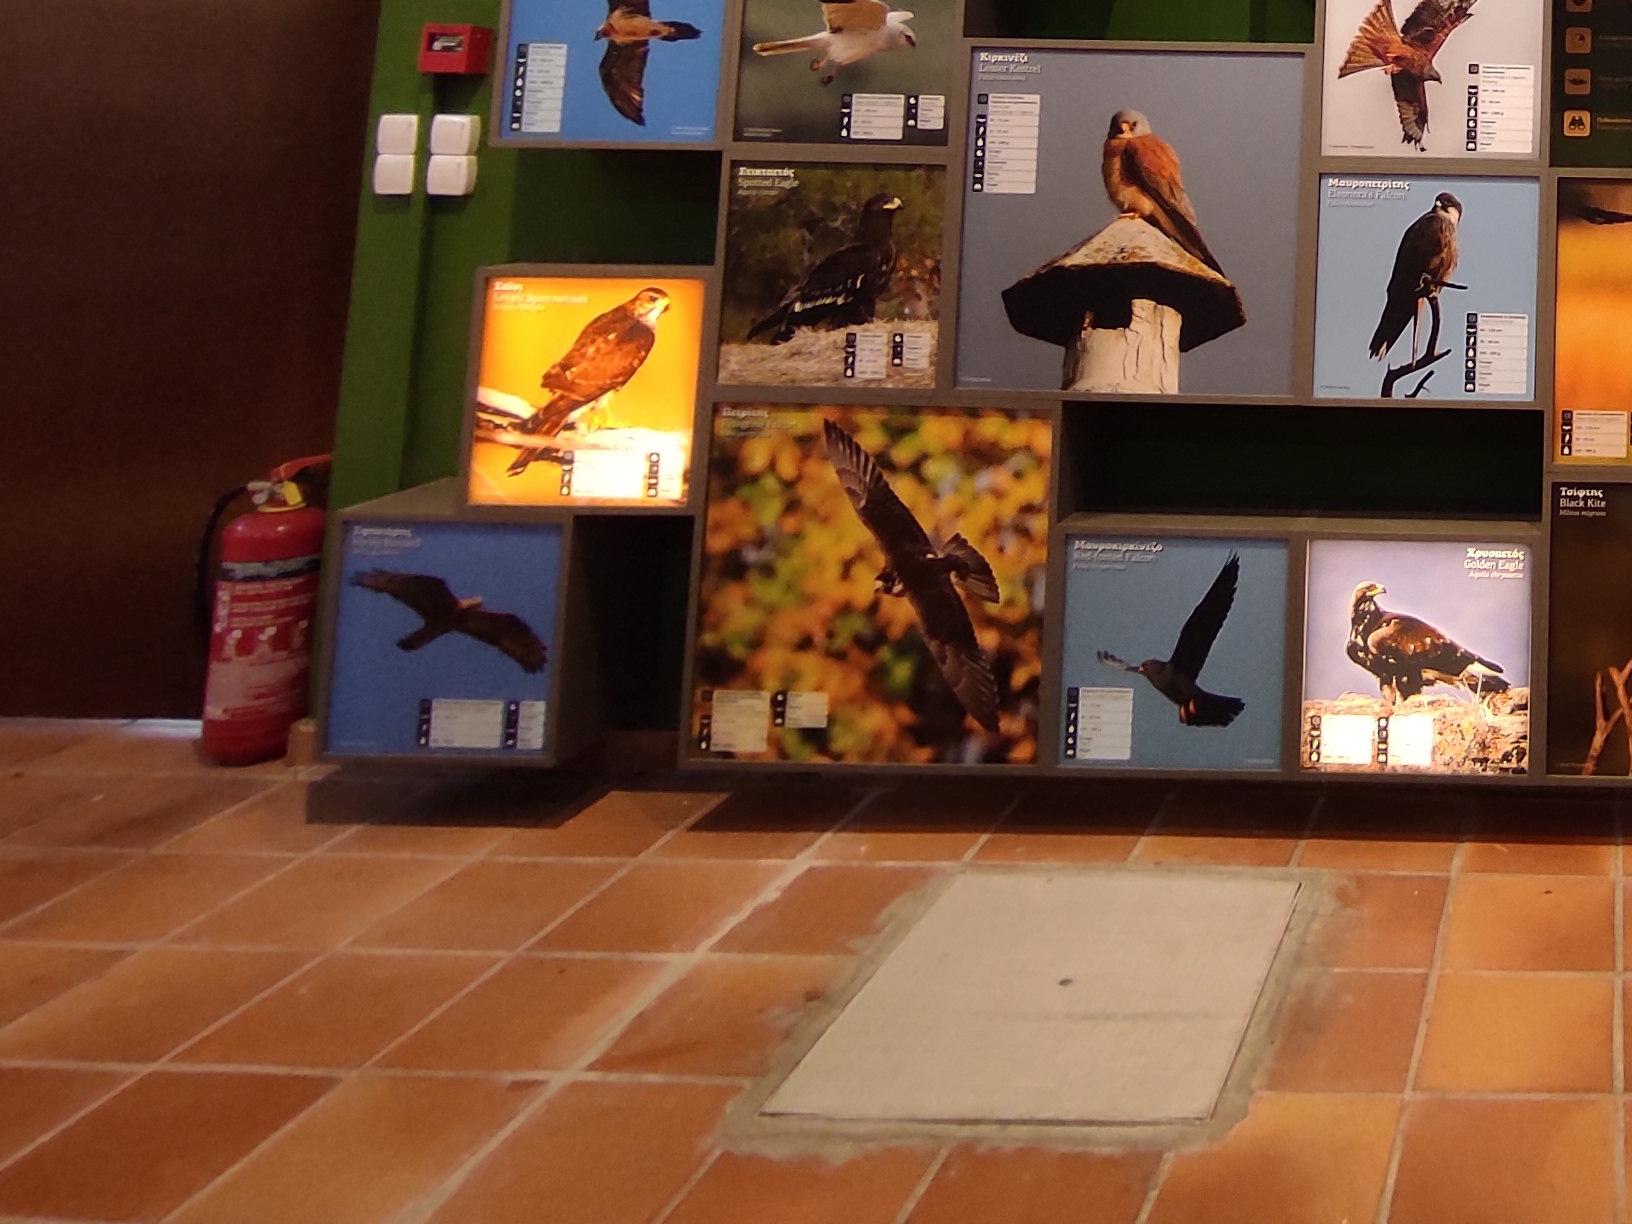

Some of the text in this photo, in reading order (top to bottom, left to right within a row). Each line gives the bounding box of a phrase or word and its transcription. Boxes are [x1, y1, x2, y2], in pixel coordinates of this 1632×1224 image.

[1560, 487, 1604, 498] Τσίφτης
[1560, 498, 1607, 508] Black Kite
[1464, 559, 1524, 572] Golden Eagle
